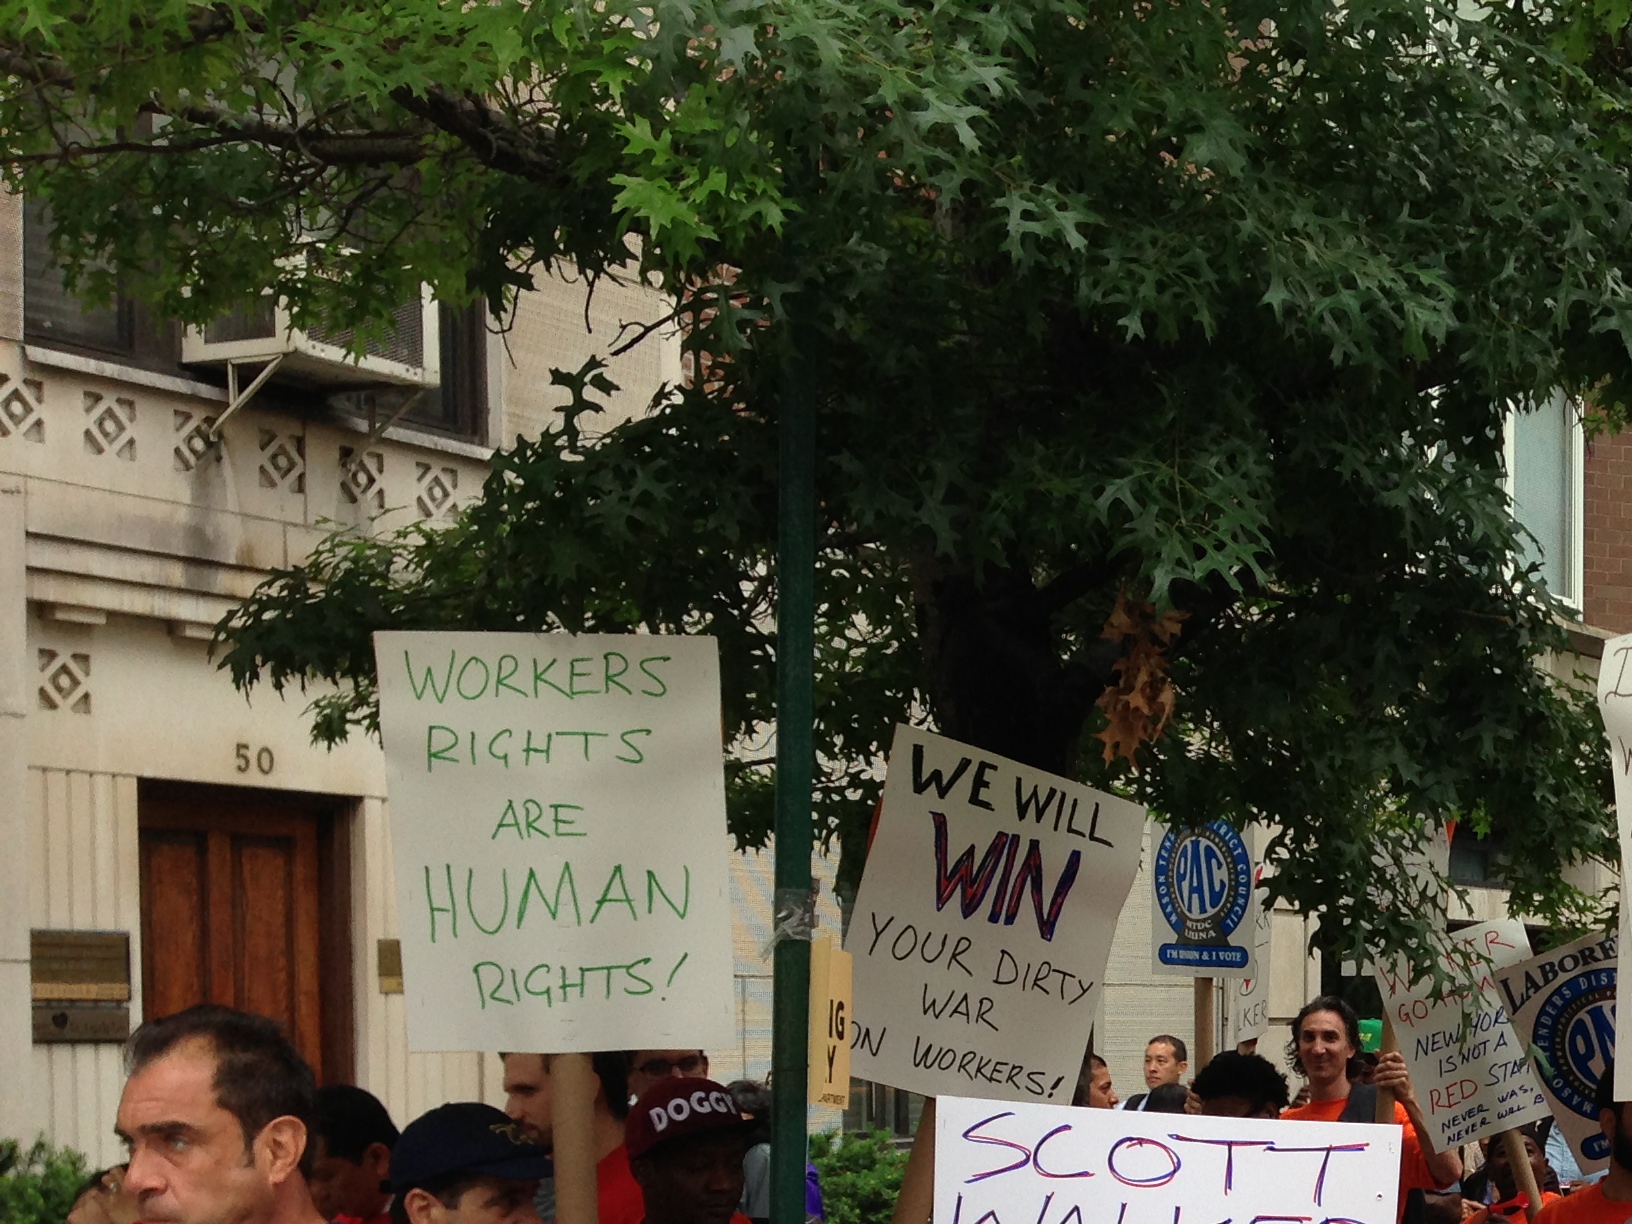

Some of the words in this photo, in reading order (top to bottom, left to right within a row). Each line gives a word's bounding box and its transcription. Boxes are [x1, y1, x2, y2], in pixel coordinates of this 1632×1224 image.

[405, 649, 672, 703] WORKERS
[235, 743, 275, 775] 50
[427, 725, 652, 773] RIGHTS
[492, 799, 588, 840] ARE
[912, 743, 998, 812] WE
[1014, 776, 1114, 848] WILL
[425, 861, 690, 943] HUMAN
[928, 811, 1081, 942] WIN
[1176, 840, 1227, 914] PAC
[473, 952, 688, 1009] RIGHTS!
[869, 913, 974, 977] YOUR
[993, 950, 1094, 1006] DIRTY
[1201, 951, 1210, 961] &
[1219, 951, 1242, 962] VOTE
[1500, 934, 1619, 1016] LABORE
[921, 984, 998, 1032] WAR
[1398, 1000, 1428, 1028] GO
[1415, 1023, 1460, 1061] NEW
[1471, 1005, 1509, 1038] YOR
[913, 1036, 1065, 1098] WORKERS!
[1439, 1056, 1457, 1077] IS
[1461, 1041, 1490, 1063] NOT
[1494, 1031, 1507, 1052] A
[1430, 1079, 1478, 1114] RED
[1442, 1104, 1489, 1133] NEVER
[1447, 1117, 1490, 1145] NEVER
[962, 1112, 1370, 1207] SCOTT
